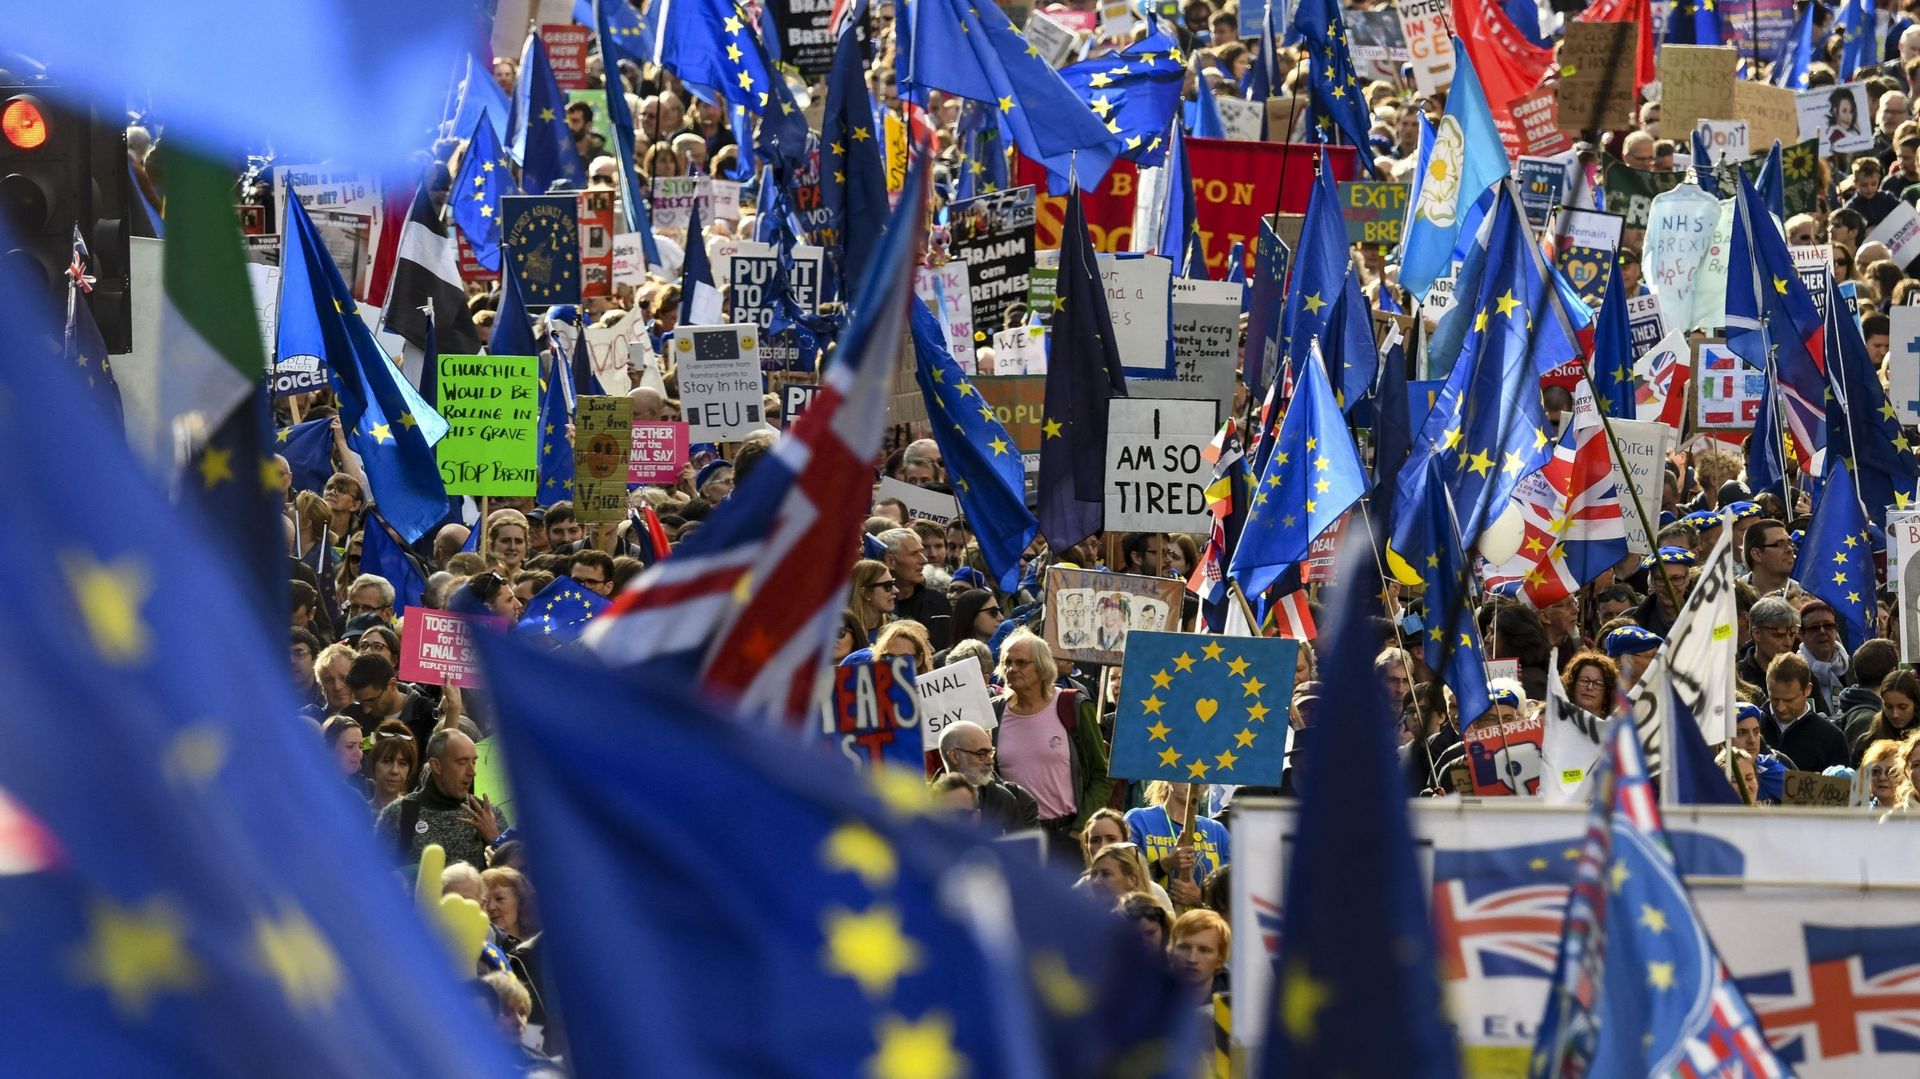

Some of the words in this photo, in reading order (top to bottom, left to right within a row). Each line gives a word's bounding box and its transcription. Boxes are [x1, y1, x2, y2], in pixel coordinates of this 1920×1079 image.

[1513, 95, 1553, 118] GREEN
[1523, 108, 1552, 128] NEW
[1701, 123, 1746, 150] Don't
[1013, 206, 1034, 218] FOR
[734, 284, 762, 308] TO
[1136, 289, 1144, 299] a
[1000, 332, 1027, 350] WE
[1201, 324, 1232, 343] every
[1206, 338, 1218, 347] to
[1199, 347, 1231, 357] secret
[440, 358, 531, 378] CHURCHILL
[1185, 360, 1197, 372] of
[442, 382, 502, 400] WOULD
[511, 385, 532, 399] BE
[683, 381, 714, 395] Stay
[719, 380, 730, 392] in
[735, 380, 758, 391] the
[443, 405, 502, 420] ROLLING
[514, 408, 531, 419] IN
[705, 402, 741, 428] EU
[1154, 408, 1160, 440] I
[446, 426, 476, 439] HIS
[480, 426, 528, 441] GRAVE
[632, 440, 646, 449] for
[647, 440, 662, 449] the
[1617, 438, 1654, 456] DITCH
[653, 450, 673, 462] SAY
[1116, 445, 1155, 471] AM
[1162, 444, 1202, 474] SO
[441, 460, 489, 484] STOP
[492, 461, 537, 482] BREXIT
[1114, 481, 1213, 517] TIRED.
[1312, 538, 1335, 553] DEAL
[1081, 573, 1115, 587] BAD
[437, 633, 453, 645] for
[422, 643, 457, 660] FINAL
[1477, 720, 1542, 740] EUROPEAN
